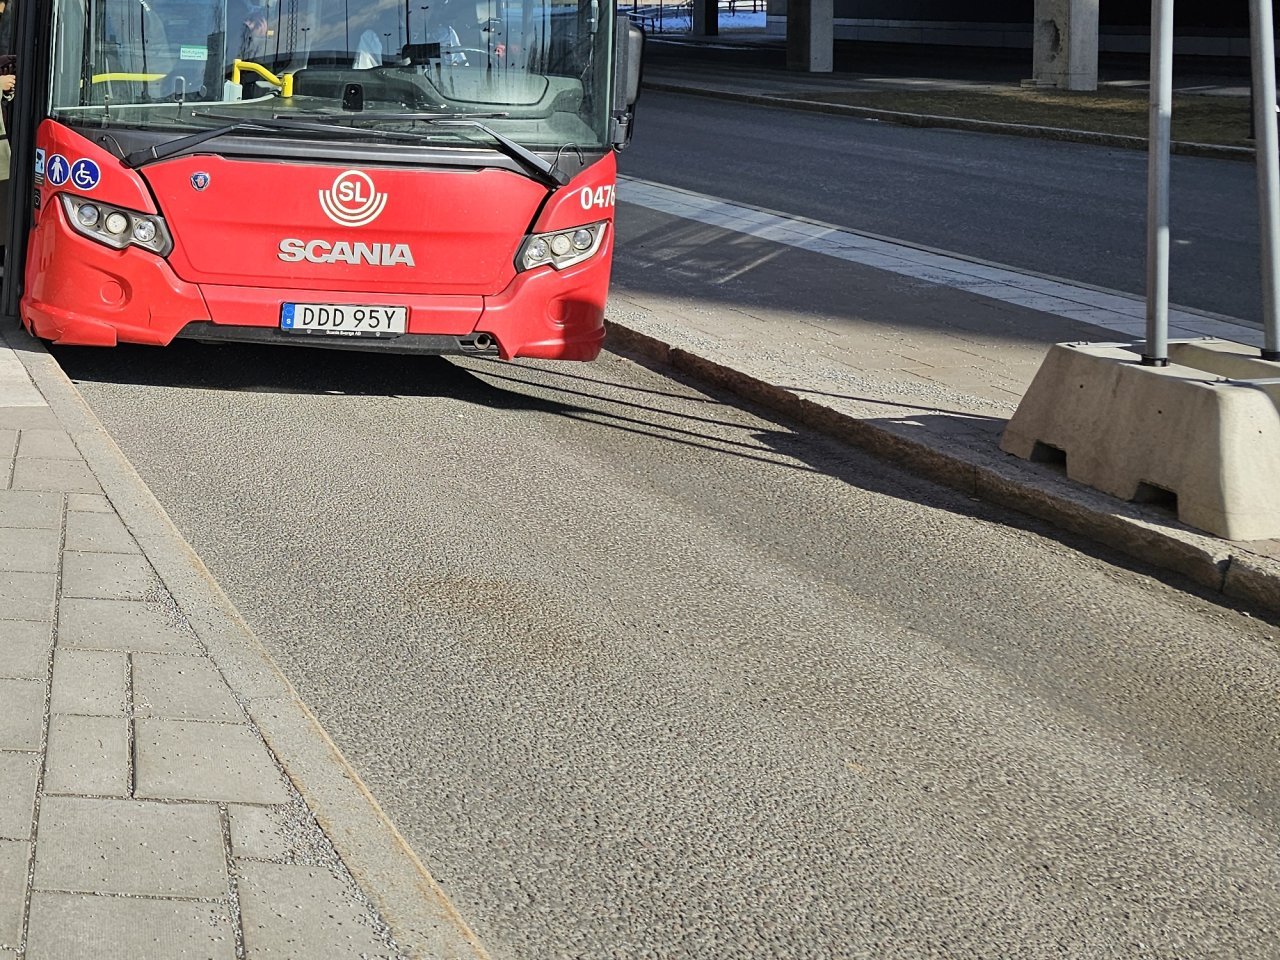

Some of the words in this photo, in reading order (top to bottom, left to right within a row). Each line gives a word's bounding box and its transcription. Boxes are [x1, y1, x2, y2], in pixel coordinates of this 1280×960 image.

[338, 181, 368, 203] SL
[580, 183, 616, 210] 0476
[277, 238, 417, 268] SCANIA
[302, 307, 345, 328] DDD
[353, 309, 397, 330] 95Y
